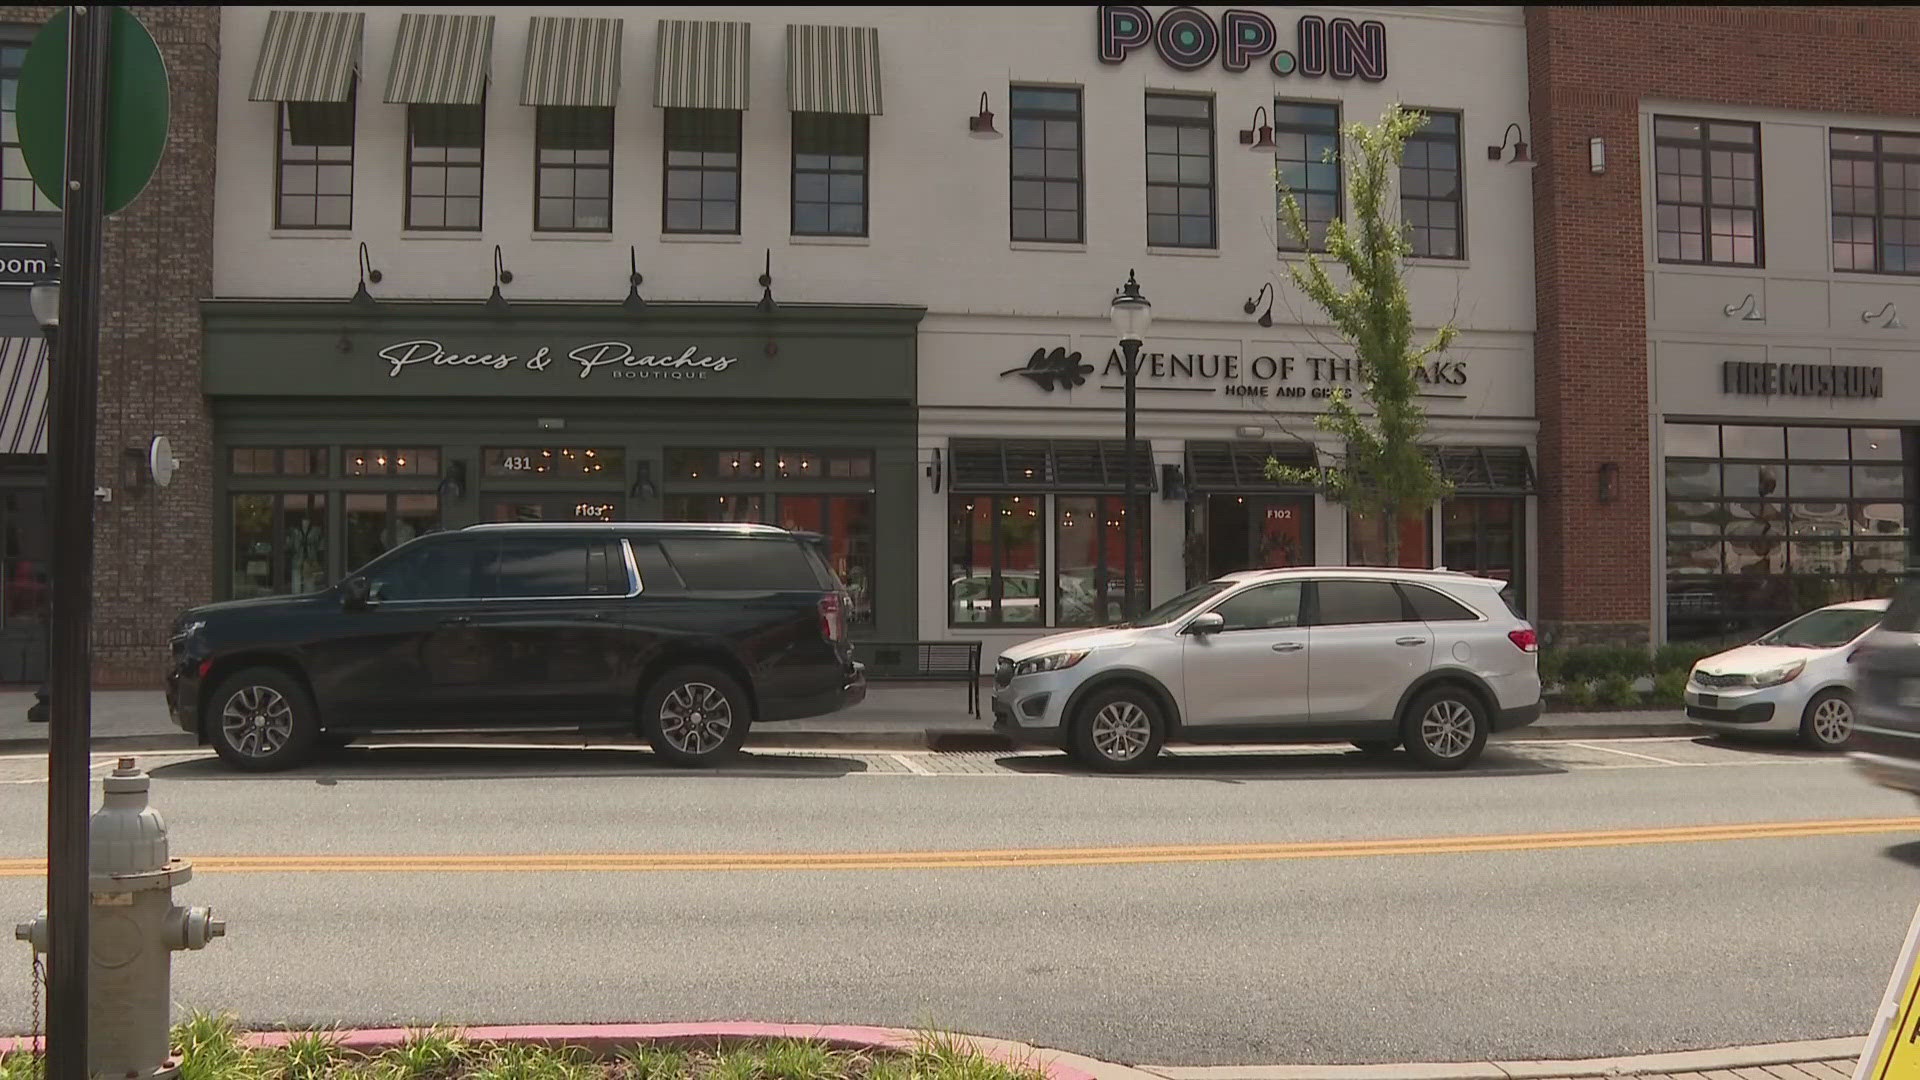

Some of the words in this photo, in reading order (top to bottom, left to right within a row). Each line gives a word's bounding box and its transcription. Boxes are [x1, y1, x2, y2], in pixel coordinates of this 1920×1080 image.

[1098, 5, 1387, 82] POP.IN
[378, 340, 517, 378] Pieces
[526, 346, 552, 371] &
[568, 341, 738, 379] Peaches
[1252, 356, 1295, 381] OF
[1409, 361, 1467, 385] AKS
[612, 371, 707, 380] BOUTIQUE
[1723, 361, 1777, 394] FIRE
[1780, 363, 1883, 397] MUSEUM
[1225, 385, 1268, 397] HOME
[1276, 387, 1306, 398] AND
[1311, 387, 1352, 400] GIS
[504, 457, 531, 470] 431
